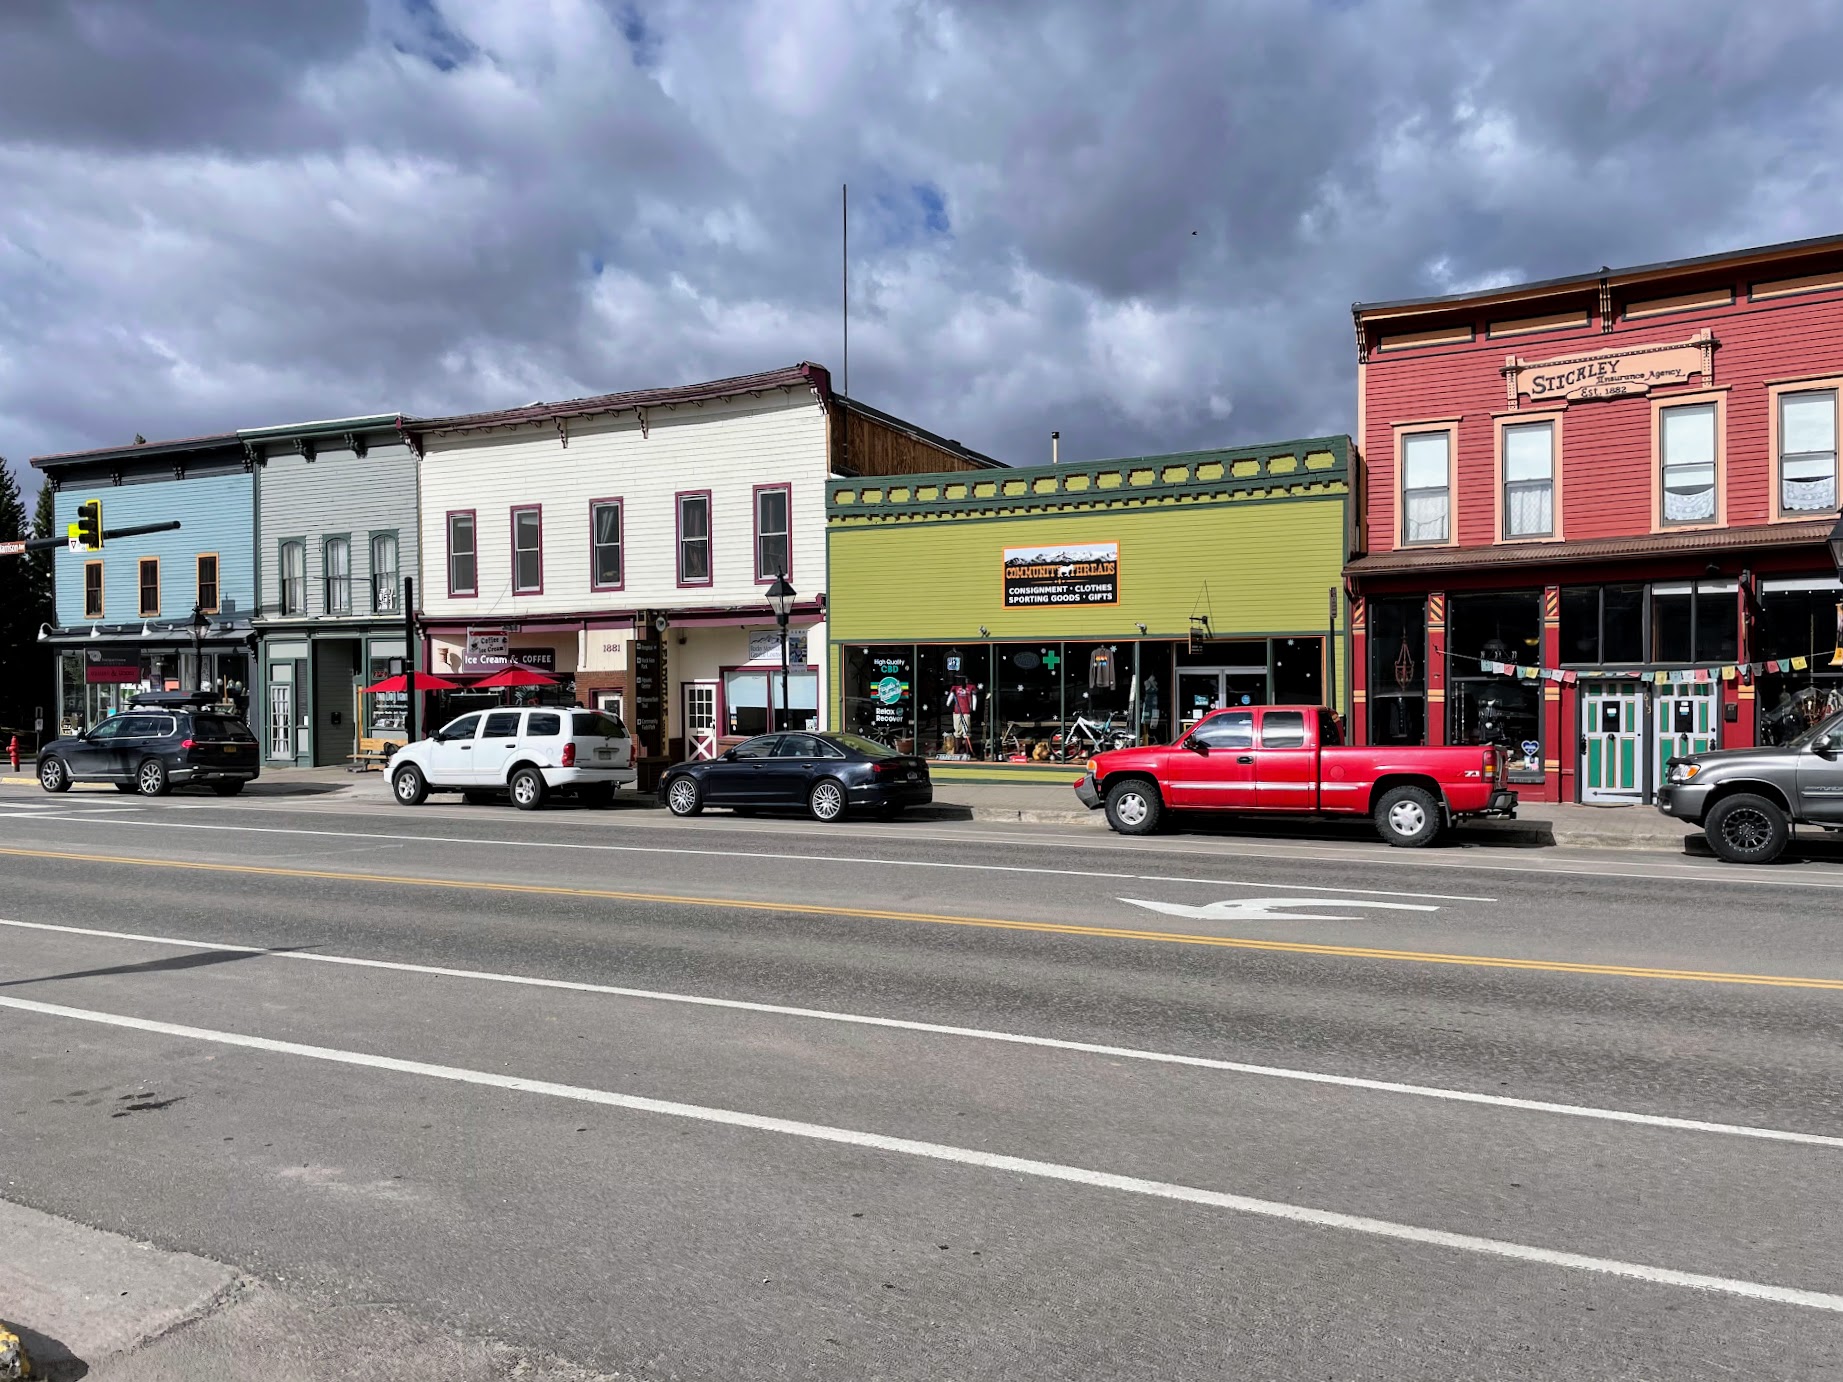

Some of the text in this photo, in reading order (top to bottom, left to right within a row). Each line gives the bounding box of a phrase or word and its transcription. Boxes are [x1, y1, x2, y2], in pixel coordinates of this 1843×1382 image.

[1532, 360, 1620, 394] STICKLEY
[1596, 369, 1685, 384] Insurance Agency
[1581, 386, 1627, 397] Est. 1882
[0, 544, 18, 553] arrison
[1009, 584, 1112, 595] CONSIGNMENT CLOTHES
[1009, 593, 1112, 604] SPORTING GOODS GIFTS
[481, 637, 499, 645] Coffee
[603, 644, 621, 653] 1881
[464, 655, 477, 664] Ice
[480, 654, 507, 664] Cream
[522, 654, 551, 663] COFFEE
[881, 665, 899, 673] CBD
